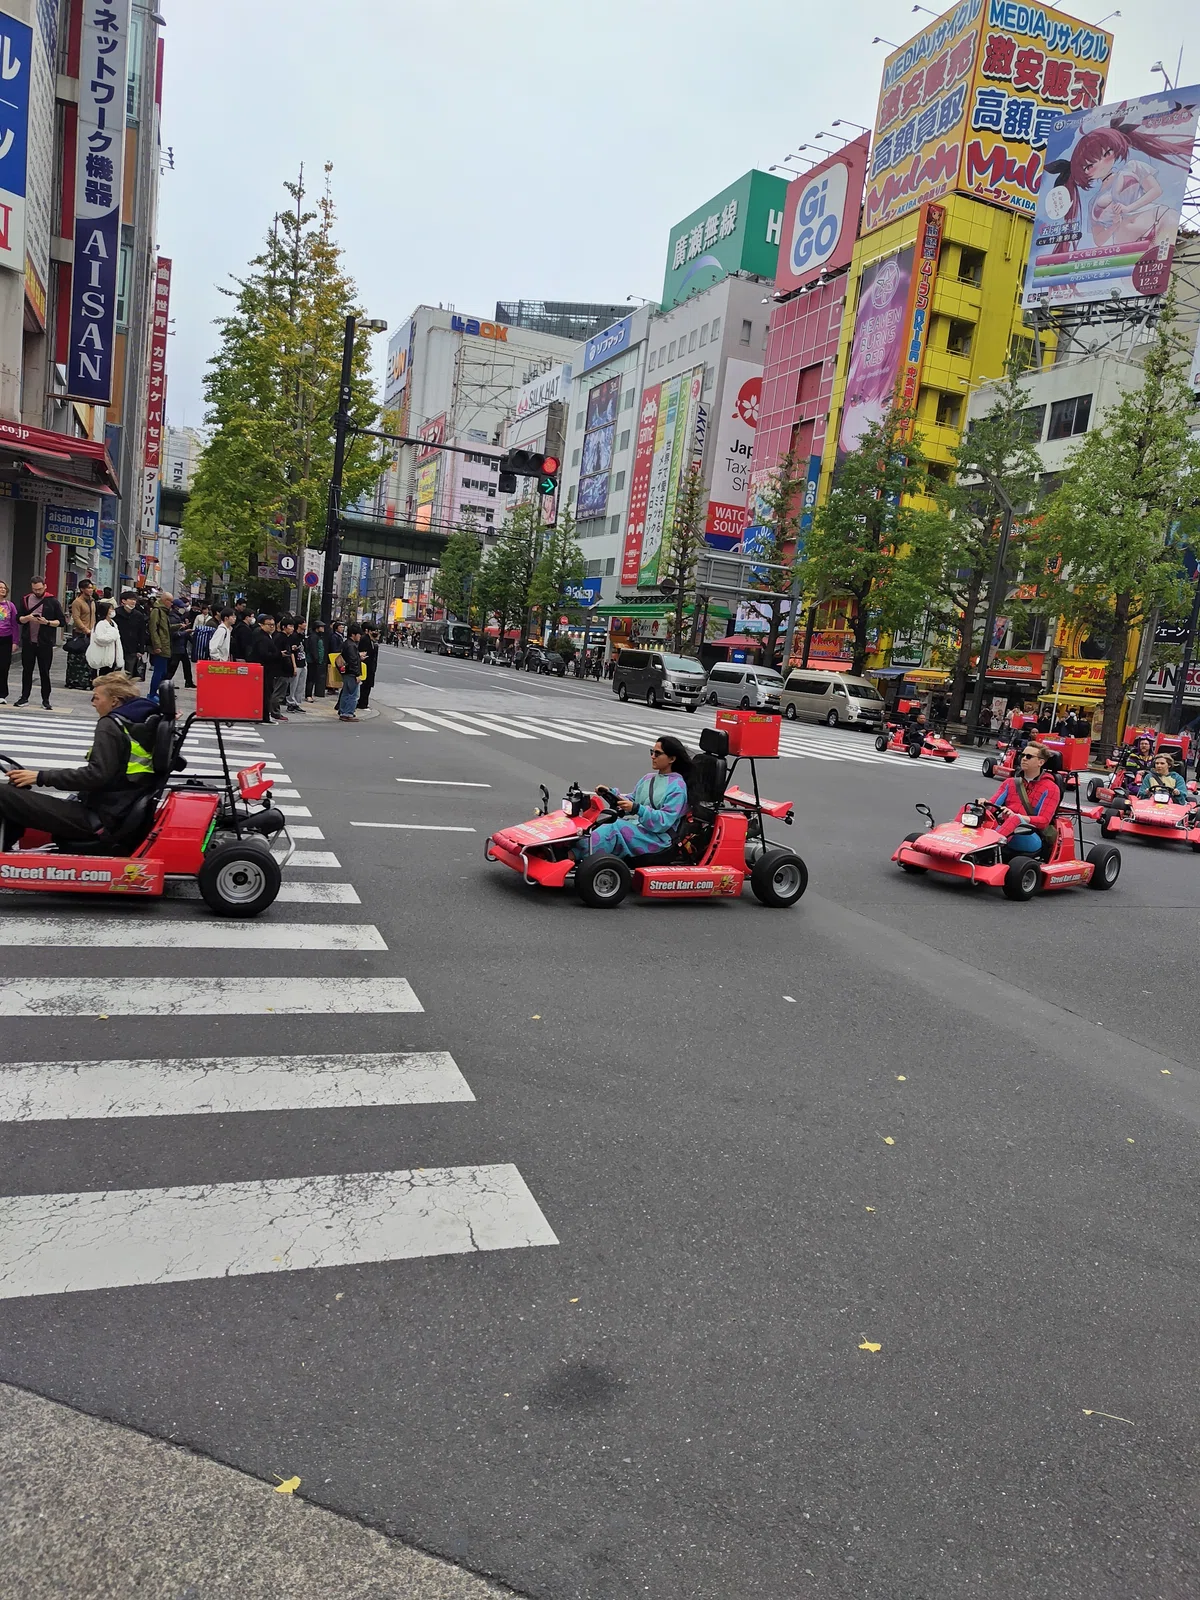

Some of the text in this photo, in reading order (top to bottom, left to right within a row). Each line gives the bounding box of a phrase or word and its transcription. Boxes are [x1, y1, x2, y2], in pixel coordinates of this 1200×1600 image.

[990, 2, 1109, 62] MEDIAリサイクル
[879, 32, 976, 132] 激安販売
[982, 33, 1102, 111] 激安販売
[871, 82, 966, 179] 高額買取
[866, 144, 959, 227] Mulan
[967, 141, 1044, 193] Mul
[897, 198, 917, 215] AKIBA
[1010, 196, 1036, 211] AKIBA
[915, 260, 932, 309] ムーラン
[1140, 277, 1159, 287] 12.3
[78, 229, 109, 381] AISAN
[860, 306, 903, 337] HEAVEN
[860, 326, 896, 353] BURNS
[908, 309, 926, 363] AKIBA
[147, 267, 170, 453] 曲数世界一 カラオケ パセラ
[863, 348, 885, 369] RED
[529, 375, 560, 409] SILK HAT
[691, 459, 701, 475] Ta
[49, 512, 95, 528] aisan.co.jp
[144, 472, 156, 527] ダーツバー
[0, 864, 43, 879] Street
[650, 880, 675, 890] Street
